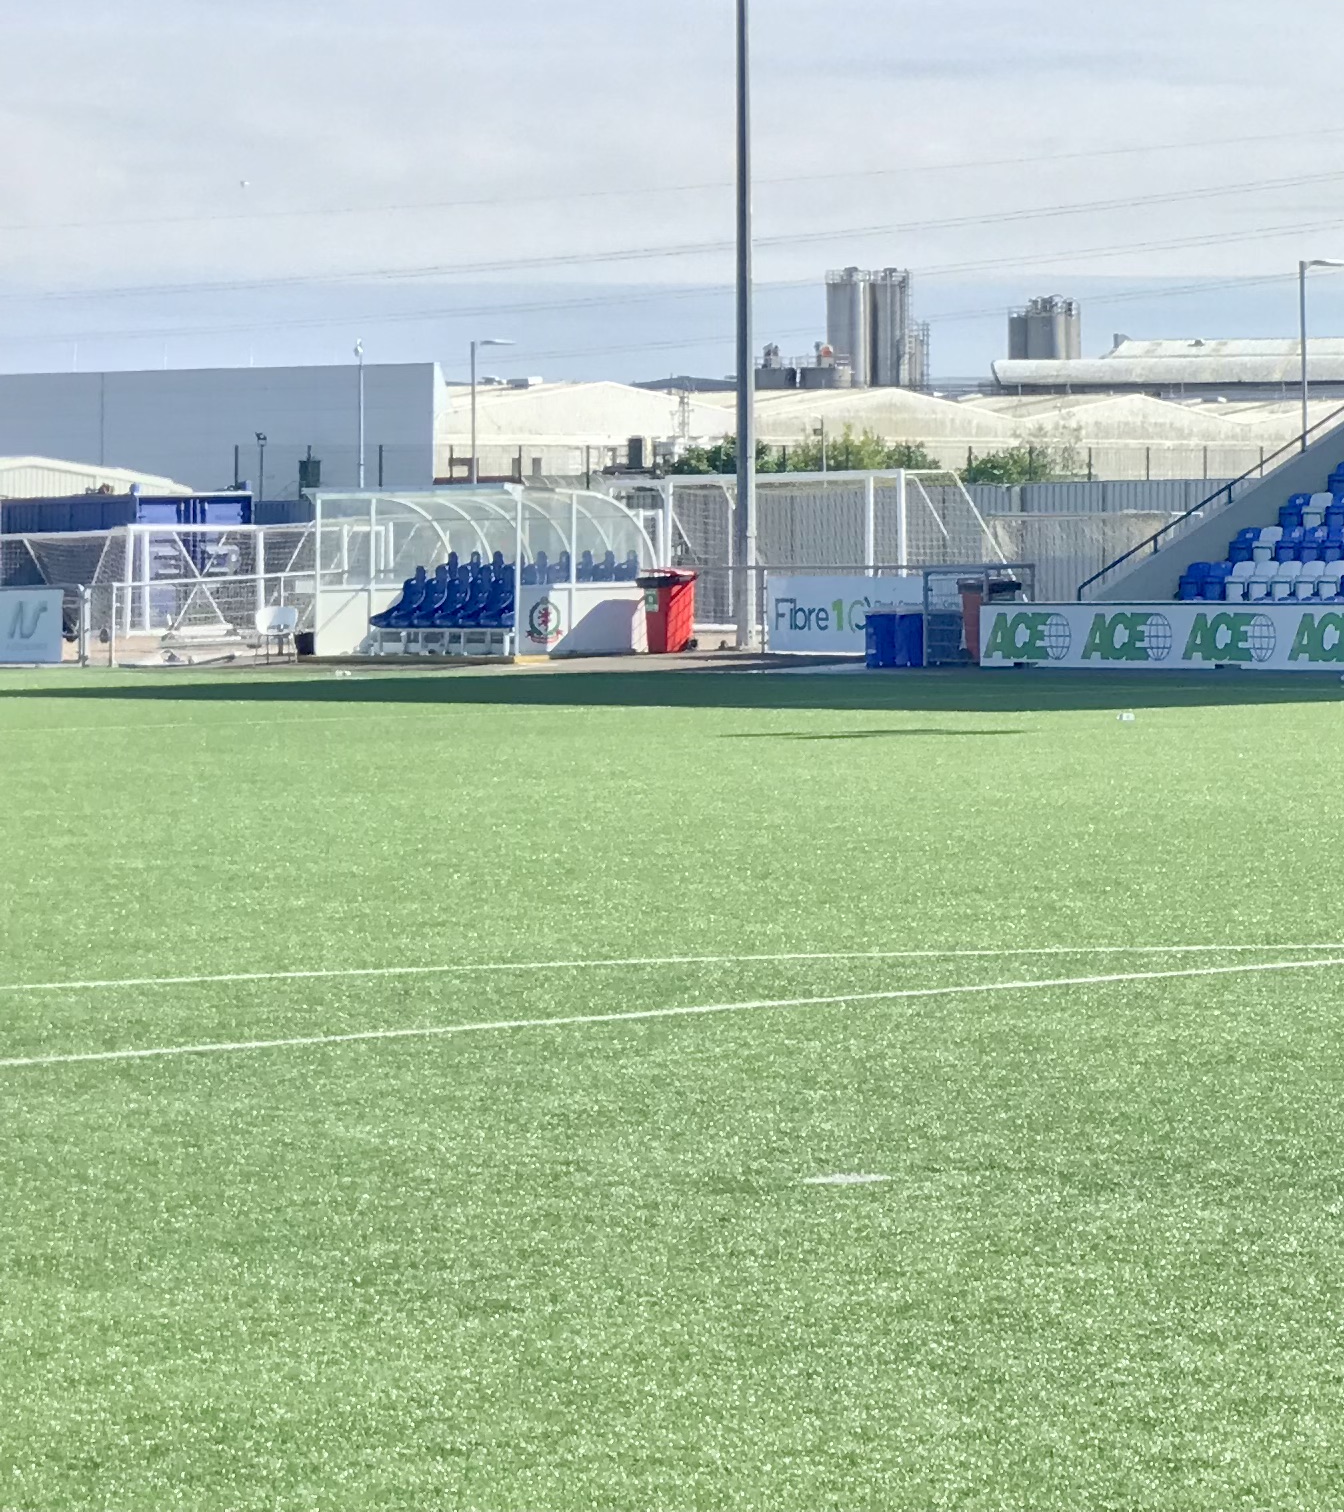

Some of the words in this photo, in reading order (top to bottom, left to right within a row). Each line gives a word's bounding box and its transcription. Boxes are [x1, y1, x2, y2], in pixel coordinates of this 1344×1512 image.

[983, 612, 1054, 660] ACE
[1081, 612, 1152, 661] ACE
[1182, 612, 1256, 662] ACE
